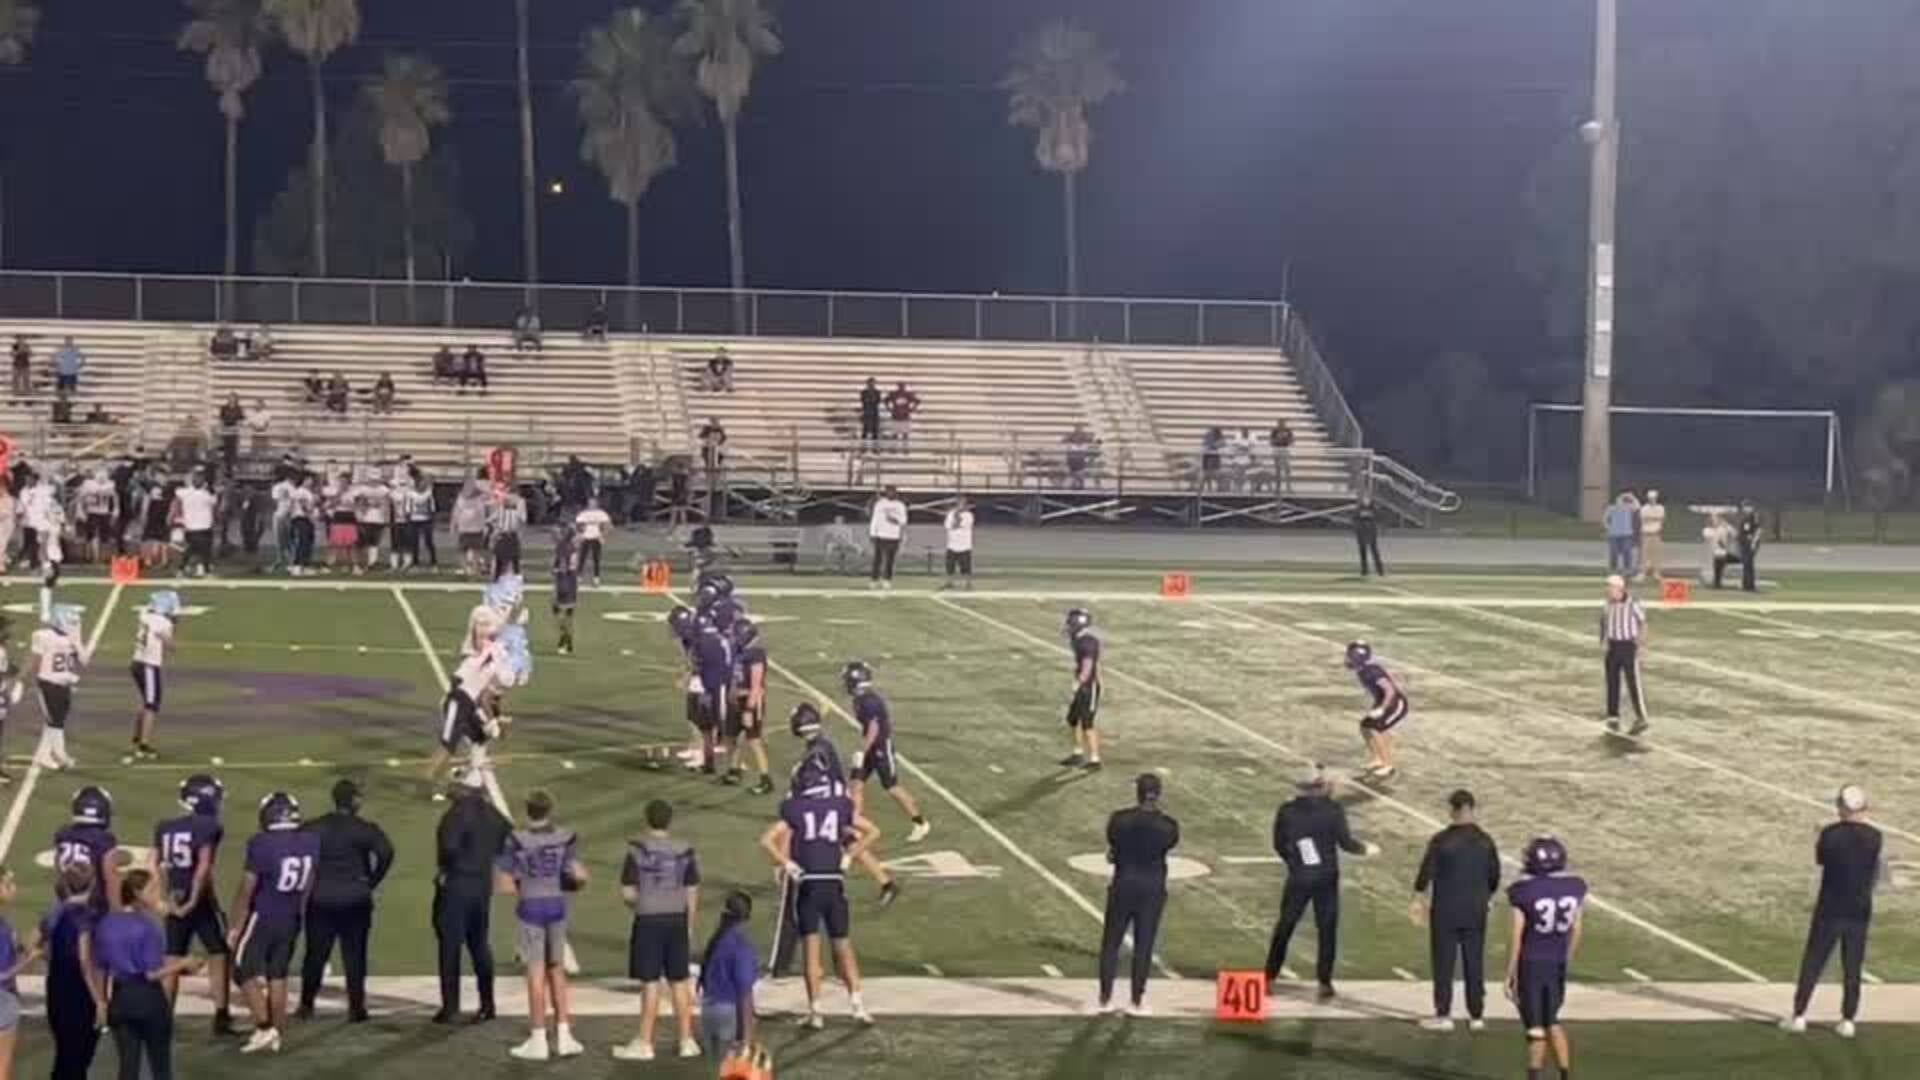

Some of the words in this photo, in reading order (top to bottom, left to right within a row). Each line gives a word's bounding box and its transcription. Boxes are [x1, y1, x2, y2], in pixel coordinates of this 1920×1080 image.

[802, 810, 838, 841] 14
[159, 832, 193, 867] 15
[277, 855, 312, 891] 61
[1534, 896, 1578, 933] 33
[1223, 976, 1260, 1013] 40
